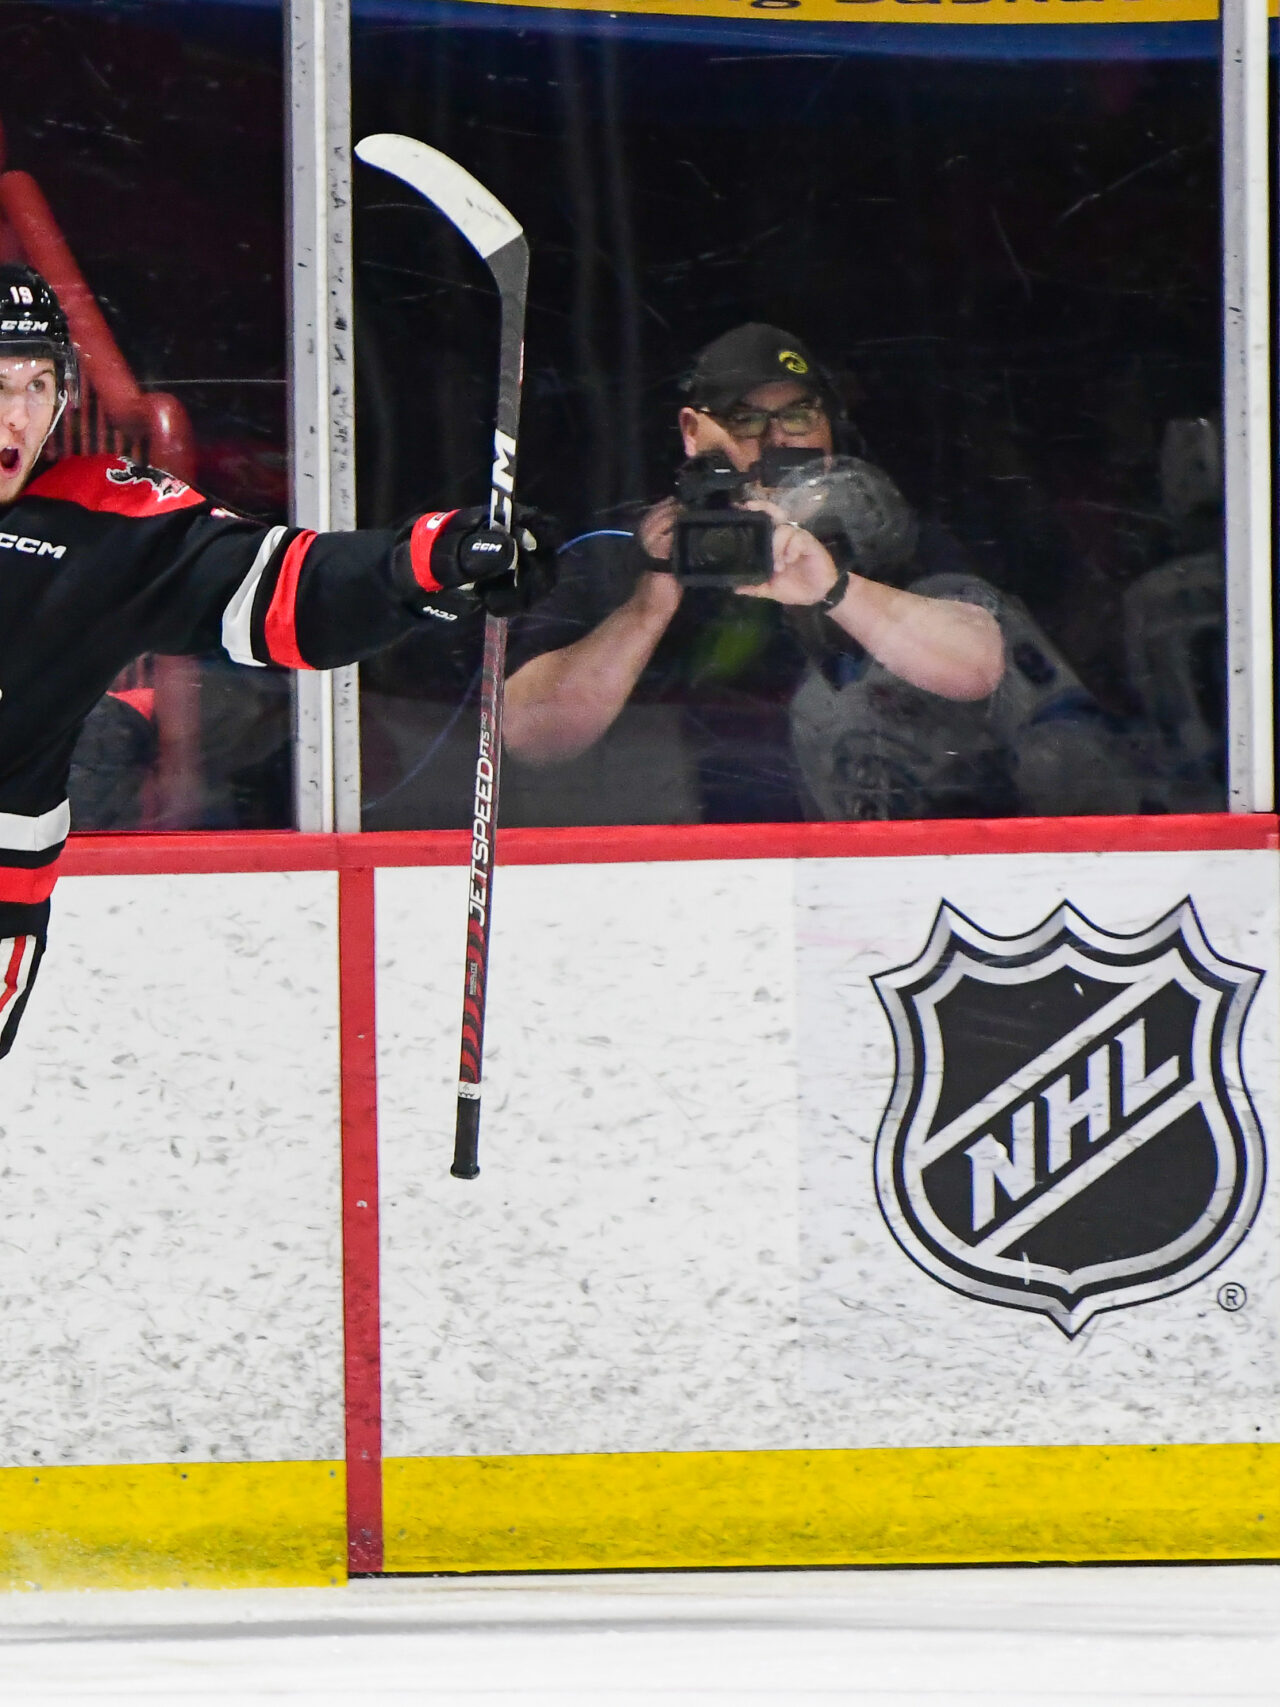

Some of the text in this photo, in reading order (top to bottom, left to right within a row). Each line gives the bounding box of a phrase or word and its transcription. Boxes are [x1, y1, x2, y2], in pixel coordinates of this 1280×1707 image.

[10, 286, 34, 305] 19
[1, 320, 49, 332] CCM
[489, 428, 517, 534] CM
[472, 541, 503, 553] CCM
[422, 605, 459, 621] CCM
[469, 757, 494, 927] JETSPEED
[963, 1017, 1180, 1232] NHL
